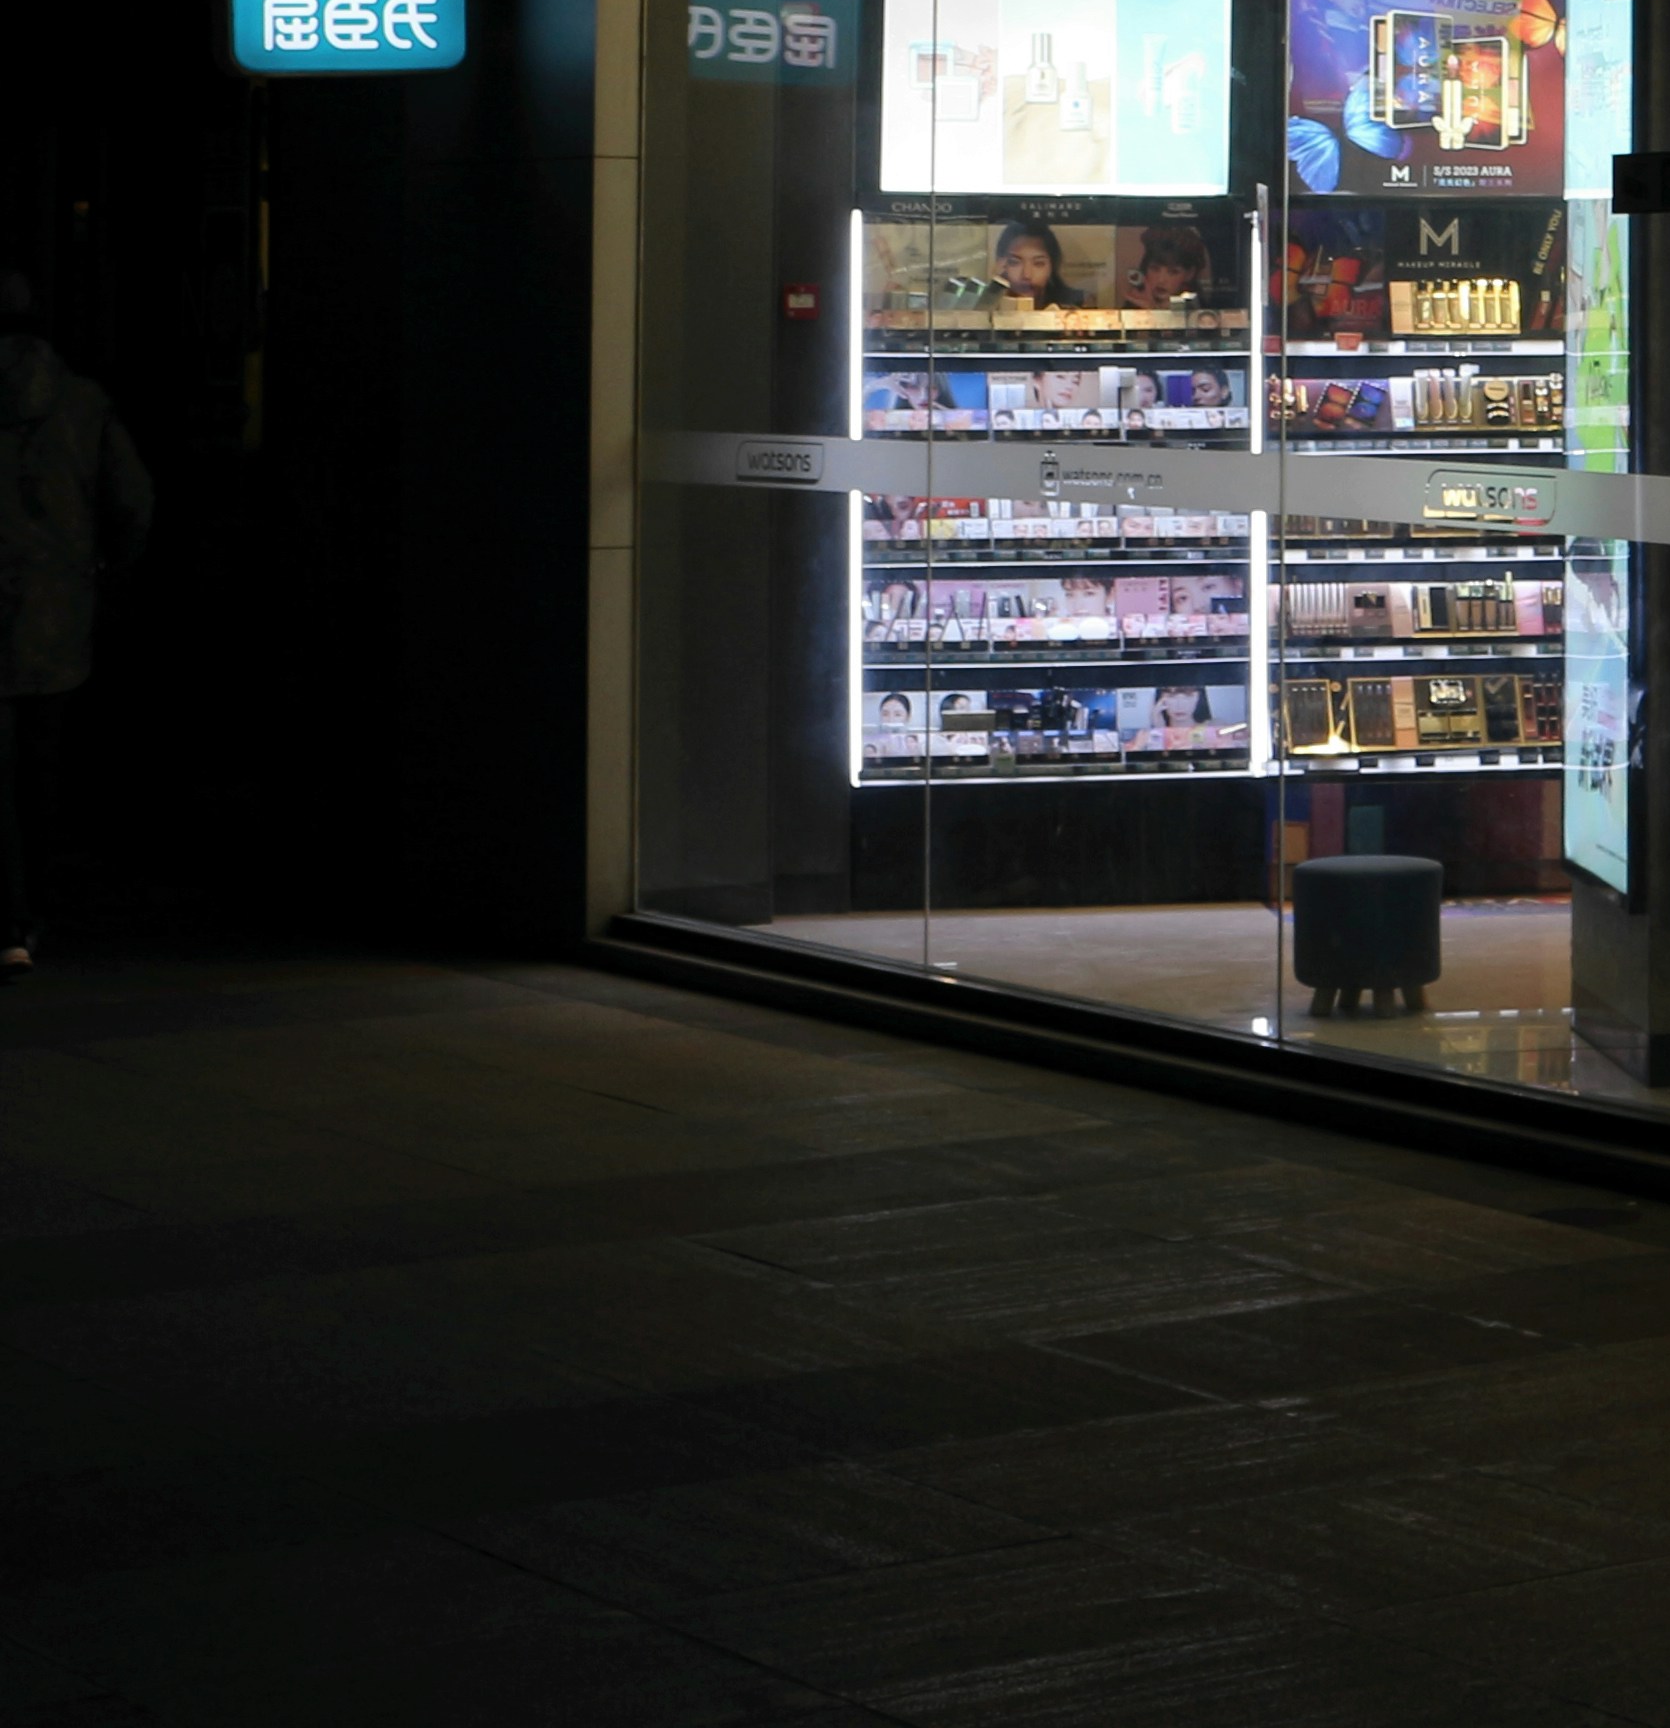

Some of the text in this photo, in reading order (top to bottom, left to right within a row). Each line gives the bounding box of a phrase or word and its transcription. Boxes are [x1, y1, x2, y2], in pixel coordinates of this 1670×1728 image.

[1480, 166, 1513, 177] AURA
[1419, 217, 1460, 255] M
[747, 451, 812, 473] watsons
